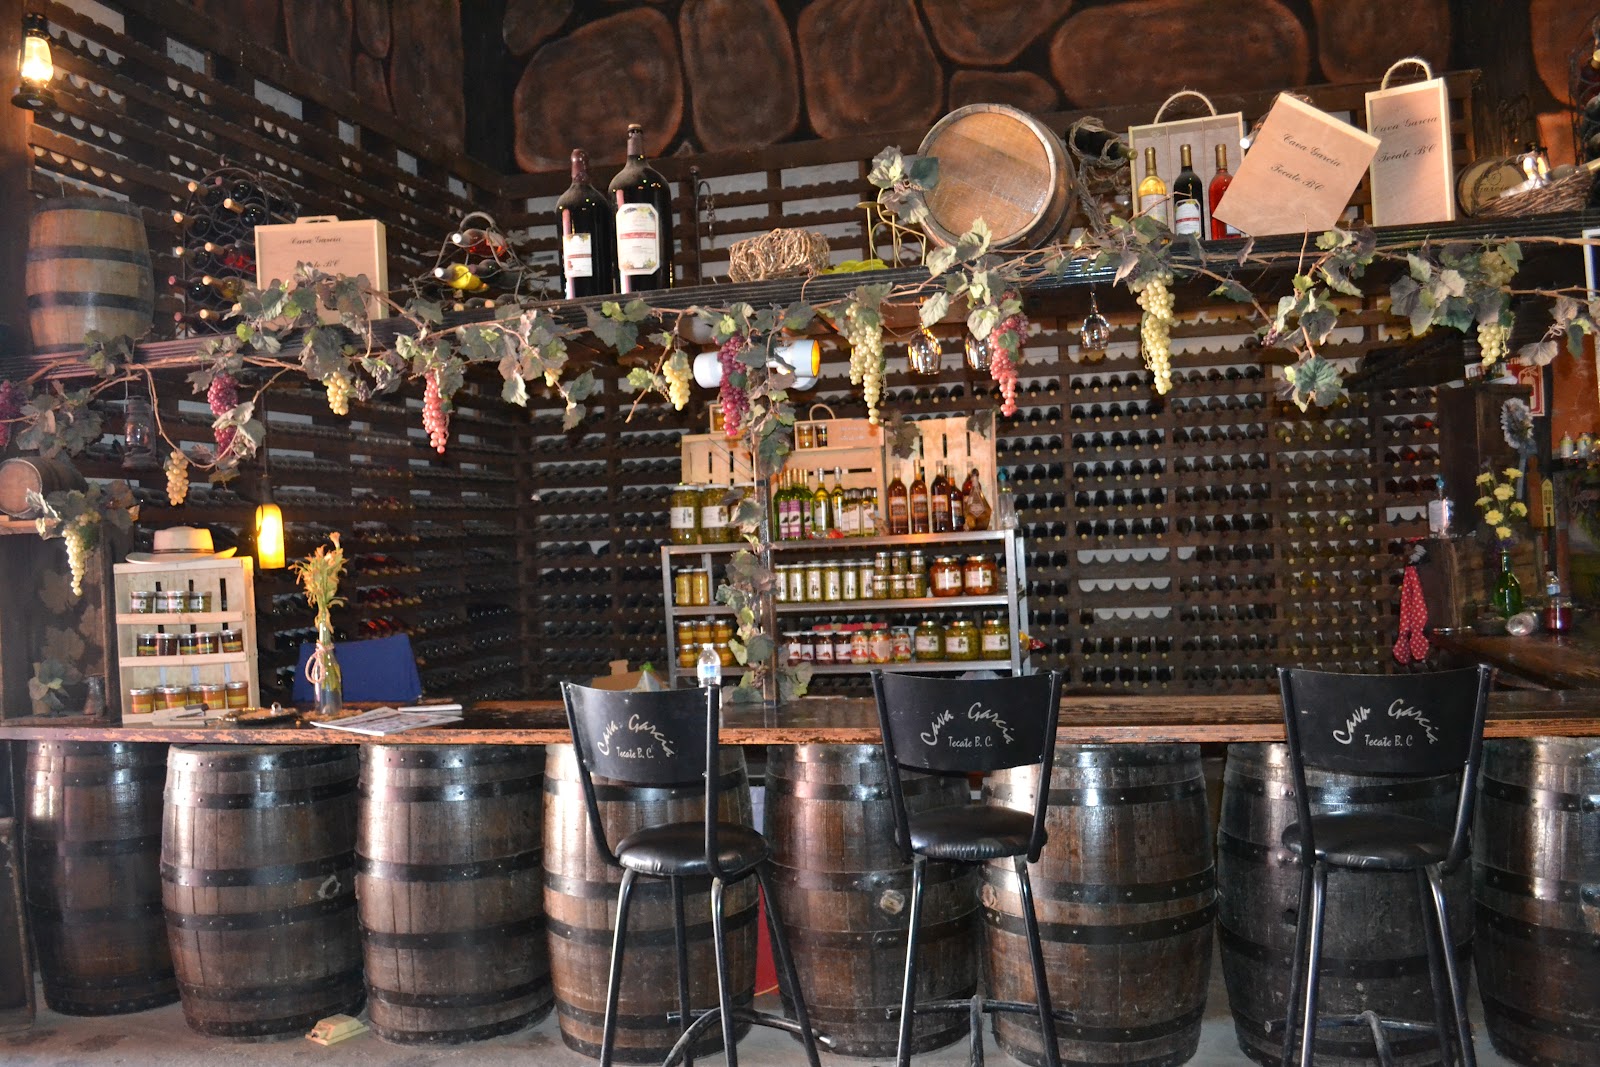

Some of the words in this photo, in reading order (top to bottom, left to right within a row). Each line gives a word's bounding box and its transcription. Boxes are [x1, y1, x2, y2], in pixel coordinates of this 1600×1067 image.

[1283, 133, 1308, 151] Cava
[1378, 149, 1411, 162] Tecate
[1270, 163, 1302, 181] Tecate
[290, 236, 312, 245] Cava
[920, 709, 955, 746] Cava
[1332, 706, 1371, 745] Cava
[597, 720, 619, 756] Cava
[948, 735, 973, 748] Tecate
[1364, 734, 1392, 747] Tecate
[616, 746, 636, 759] Tecate
